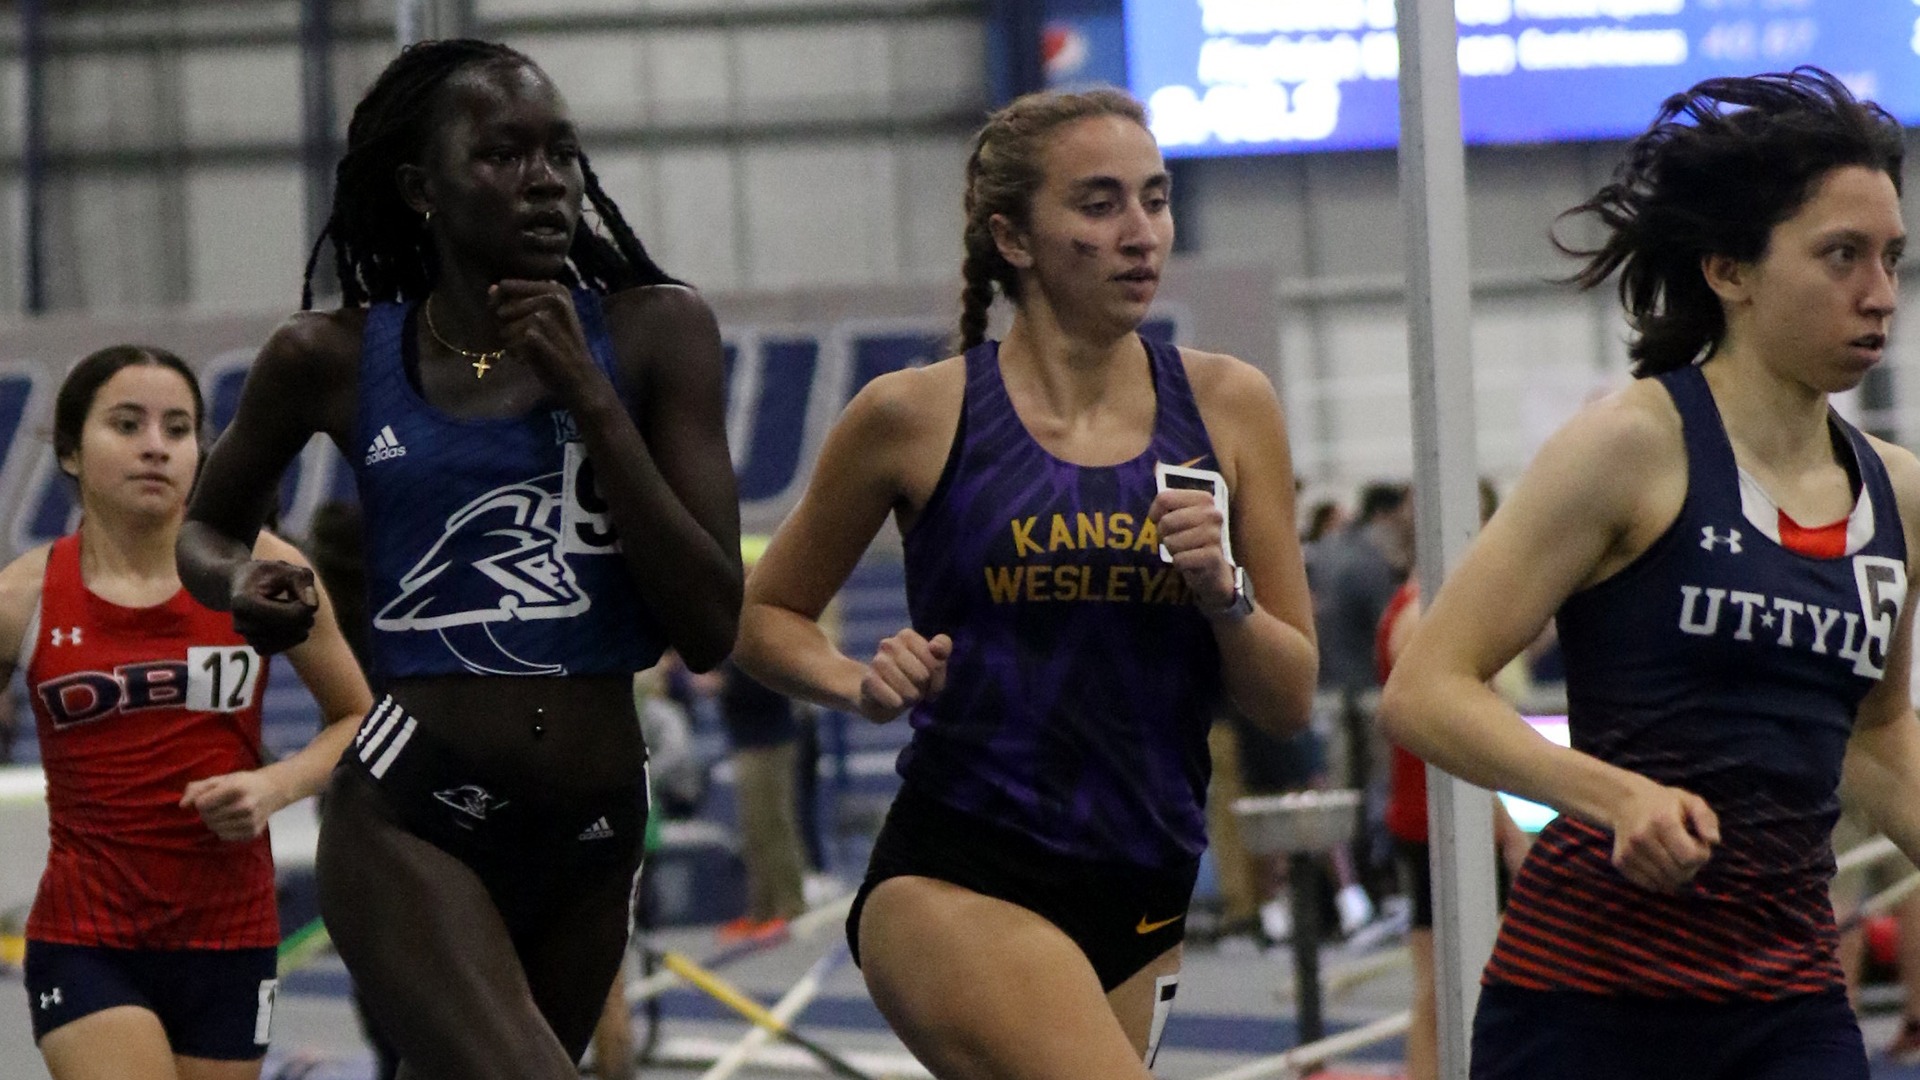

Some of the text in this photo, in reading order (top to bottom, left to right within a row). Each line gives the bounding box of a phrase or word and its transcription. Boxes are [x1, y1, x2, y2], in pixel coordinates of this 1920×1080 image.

[365, 445, 407, 466] adidas
[574, 457, 619, 547] 9
[1011, 512, 1158, 558] KANSA
[1774, 597, 1859, 661] TYL
[1865, 564, 1898, 670] 5
[37, 660, 187, 729] DB
[202, 650, 250, 708] 12
